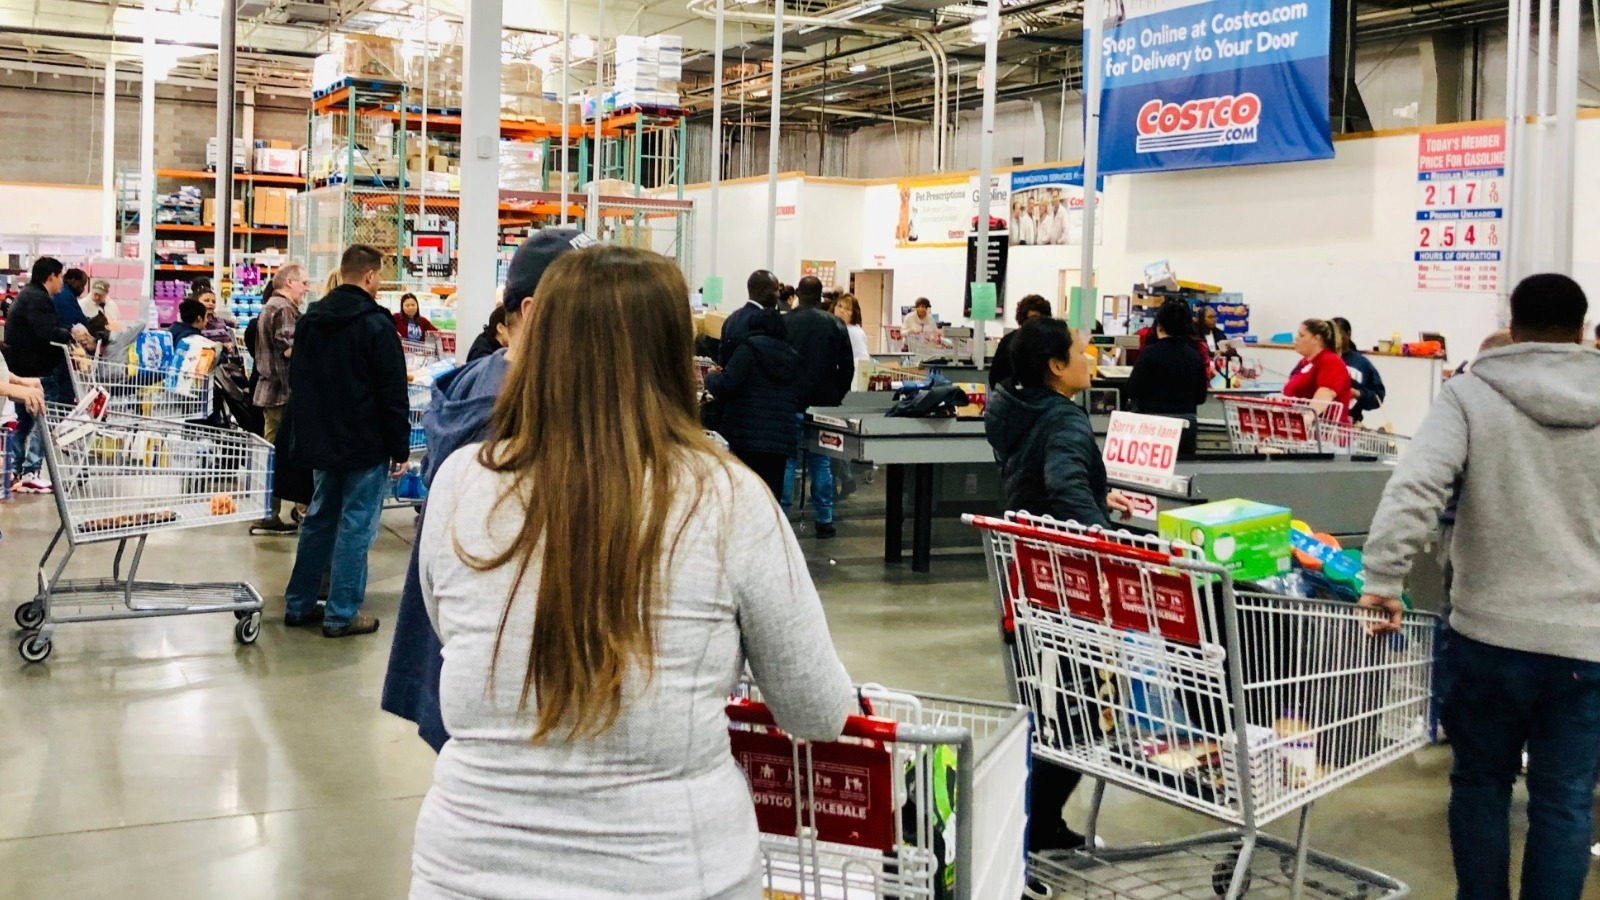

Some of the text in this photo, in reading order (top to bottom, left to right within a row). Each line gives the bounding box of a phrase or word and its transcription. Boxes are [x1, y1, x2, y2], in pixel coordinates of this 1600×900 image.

[1102, 2, 1308, 57] Shop Online at Costco.com
[1105, 30, 1299, 77] for Delivery to Your Door
[1137, 92, 1262, 136] COSTCO
[1426, 134, 1500, 153] TODAY'S MEMBER
[1419, 151, 1505, 170] PRICE FOR GASOLINE
[915, 190, 966, 202] Pet Prescriptions
[1419, 251, 1498, 260] HOURS OF OPERATION
[1110, 419, 1178, 439] Sorry, this lane
[1106, 437, 1174, 470] CLOSED
[753, 792, 792, 808] OSTCO
